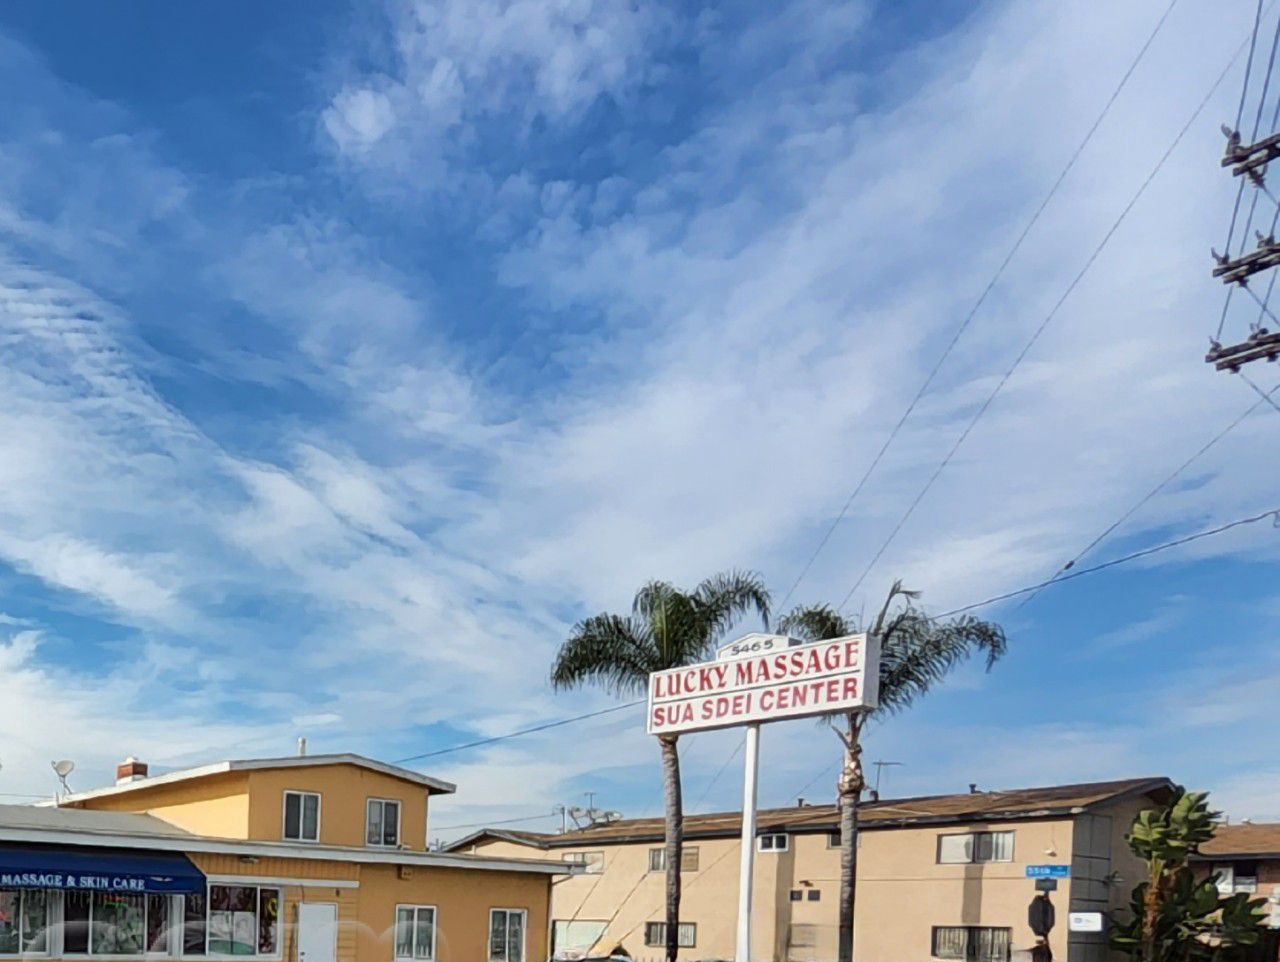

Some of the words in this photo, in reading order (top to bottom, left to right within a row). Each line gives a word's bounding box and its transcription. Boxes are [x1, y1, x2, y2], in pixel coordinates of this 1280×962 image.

[731, 640, 774, 656] 5465
[654, 664, 729, 698] LUCKY
[735, 641, 860, 686] MASSAGE
[653, 703, 694, 727] SUA
[702, 692, 752, 720] SDEI
[760, 677, 858, 711] CENTER
[1, 874, 62, 886] MASSAGE
[67, 874, 78, 887] &
[80, 876, 109, 889] SKIN
[113, 878, 145, 890] CARE
